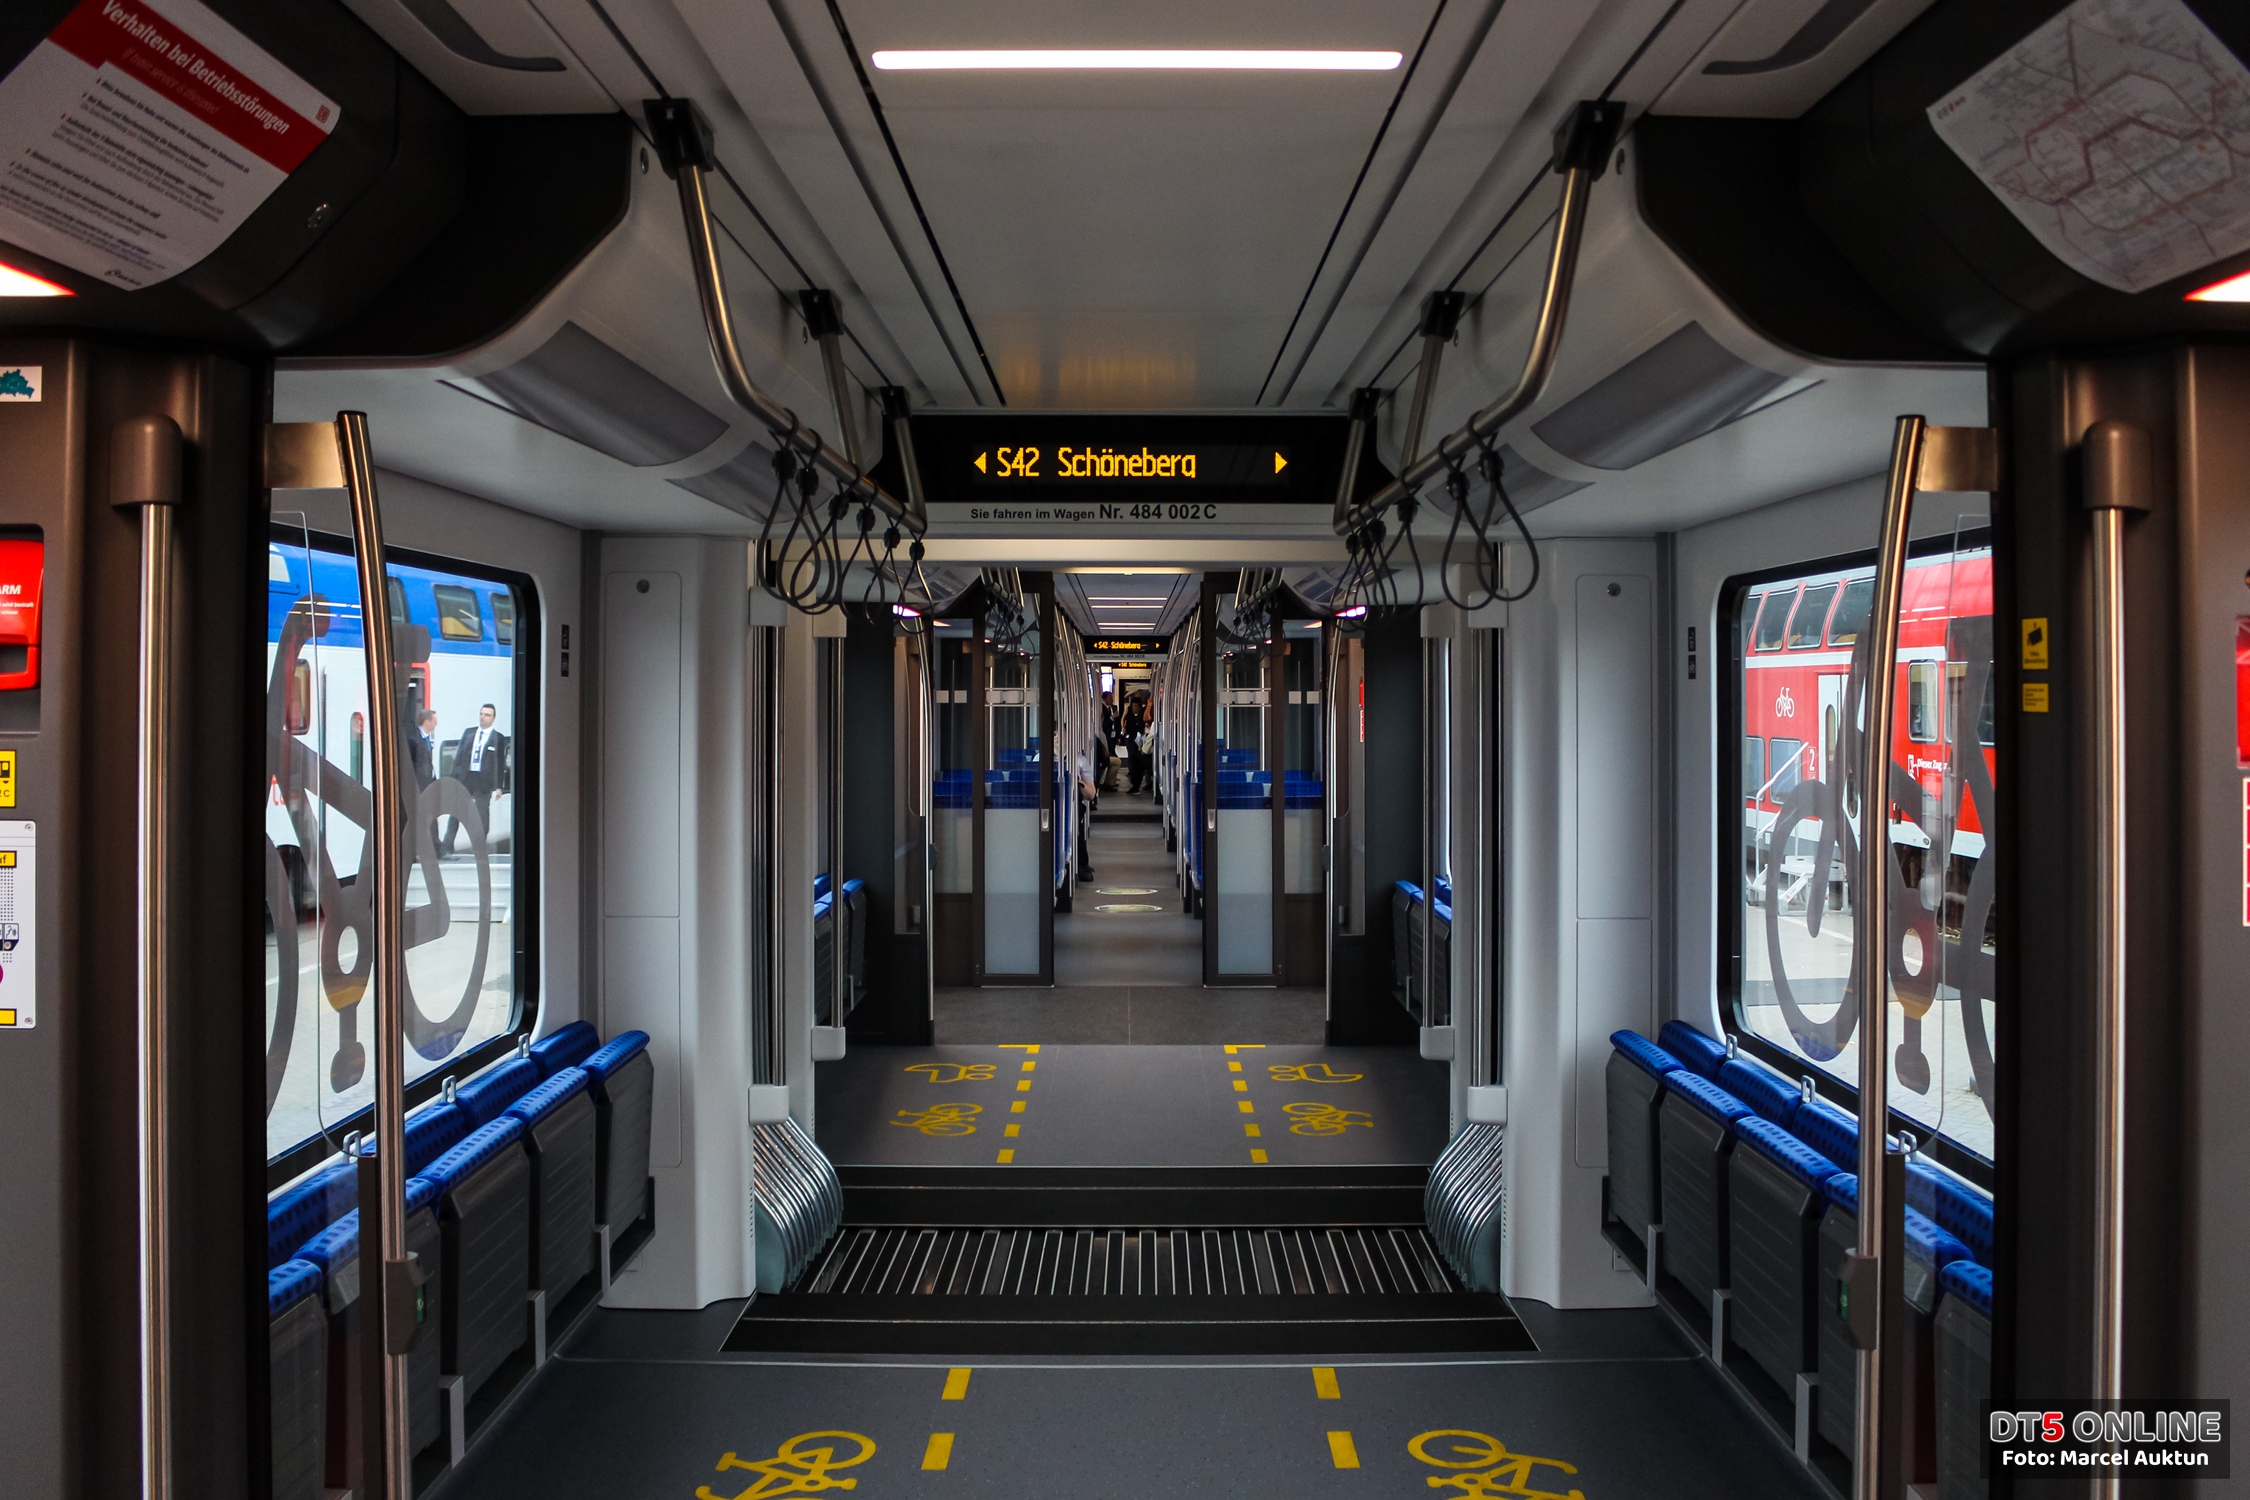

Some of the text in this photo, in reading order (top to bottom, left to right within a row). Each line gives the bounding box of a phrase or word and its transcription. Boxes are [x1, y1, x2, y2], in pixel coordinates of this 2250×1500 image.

[102, 0, 170, 54] Verhalten
[167, 44, 196, 68] bei
[189, 58, 290, 135] Betriebsstörungen
[130, 52, 151, 71] train
[149, 62, 177, 90] service
[176, 83, 185, 95] is
[182, 87, 220, 115] disrupted
[997, 447, 1196, 479] S42 Schöneberg
[970, 508, 990, 519] Sie
[993, 508, 1032, 519] fahren
[1035, 508, 1050, 519] im
[1053, 509, 1095, 521] Wagen
[1099, 505, 1124, 520] Nr.
[1129, 505, 1162, 520] 484
[1098, 641, 1108, 649] S42
[1809, 748, 1816, 772] 2
